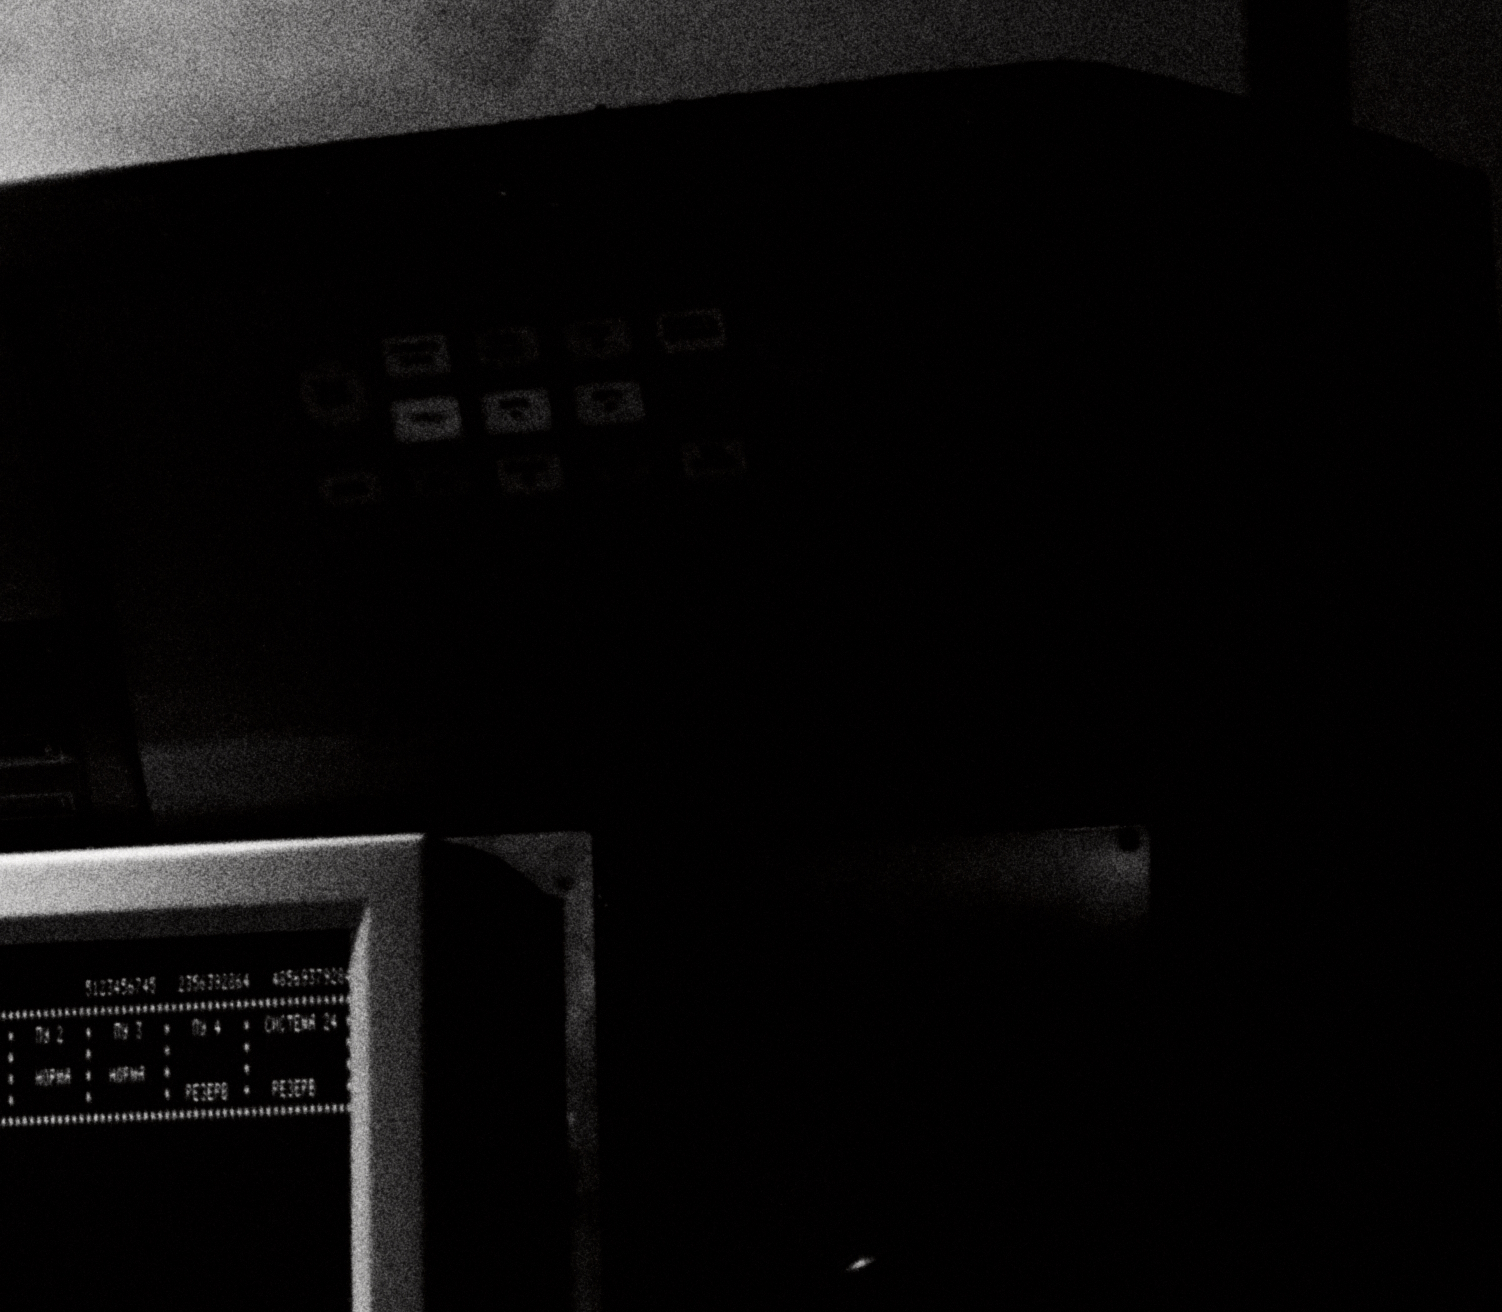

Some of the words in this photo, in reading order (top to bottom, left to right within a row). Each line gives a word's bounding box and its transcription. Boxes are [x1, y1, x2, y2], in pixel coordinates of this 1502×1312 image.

[213, 1017, 223, 1035] 4
[322, 1012, 338, 1032] 24
[184, 1081, 229, 1103] РЕЗЕРВ
[271, 1077, 316, 1099] РЕЗЕРВ
